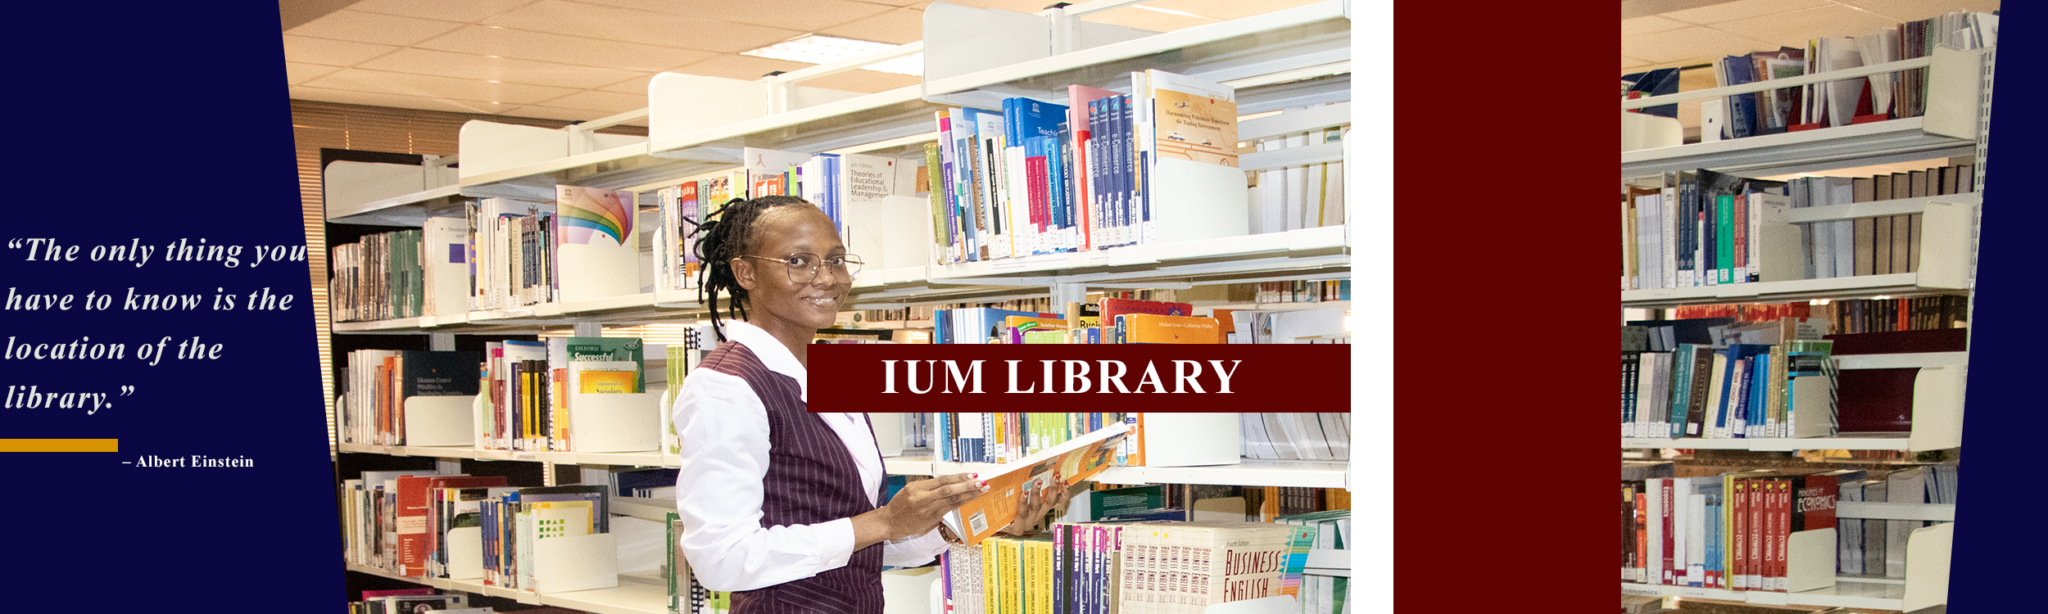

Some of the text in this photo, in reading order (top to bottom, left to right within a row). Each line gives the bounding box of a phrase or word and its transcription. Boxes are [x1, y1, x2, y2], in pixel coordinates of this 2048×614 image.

[1183, 120, 1198, 128] Trading
[1198, 123, 1220, 131] Environment
[1091, 138, 1101, 177] e-Commerce
[1101, 136, 1111, 175] e-Commerce
[1112, 134, 1122, 174] e-Commerce
[1125, 132, 1135, 172] e-Commerce
[850, 170, 875, 178] Theories
[851, 177, 884, 185] Educational
[851, 184, 882, 192] Leadership
[575, 352, 614, 361] Successful
[1798, 489, 1818, 498] PRINCIPLES
[1798, 495, 1836, 512] ECONOMICS
[1125, 545, 1135, 589] BUSINESS ENGLISH
[1137, 545, 1147, 590] BUSINESS ENGLISH
[1148, 546, 1158, 591] BUSINESS ENGLISH
[1160, 547, 1170, 592] BUSINESS ENGLISH
[1169, 546, 1180, 591] BUSINESS ENGLISH
[1180, 547, 1191, 592] BUSINESS ENGLISH
[1191, 548, 1202, 593] BUSINESS ENGLISH
[1201, 548, 1211, 594] BUSINESS ENGLISH
[1225, 549, 1281, 576] BUSINESS
[1224, 577, 1269, 602] ENGLISH
